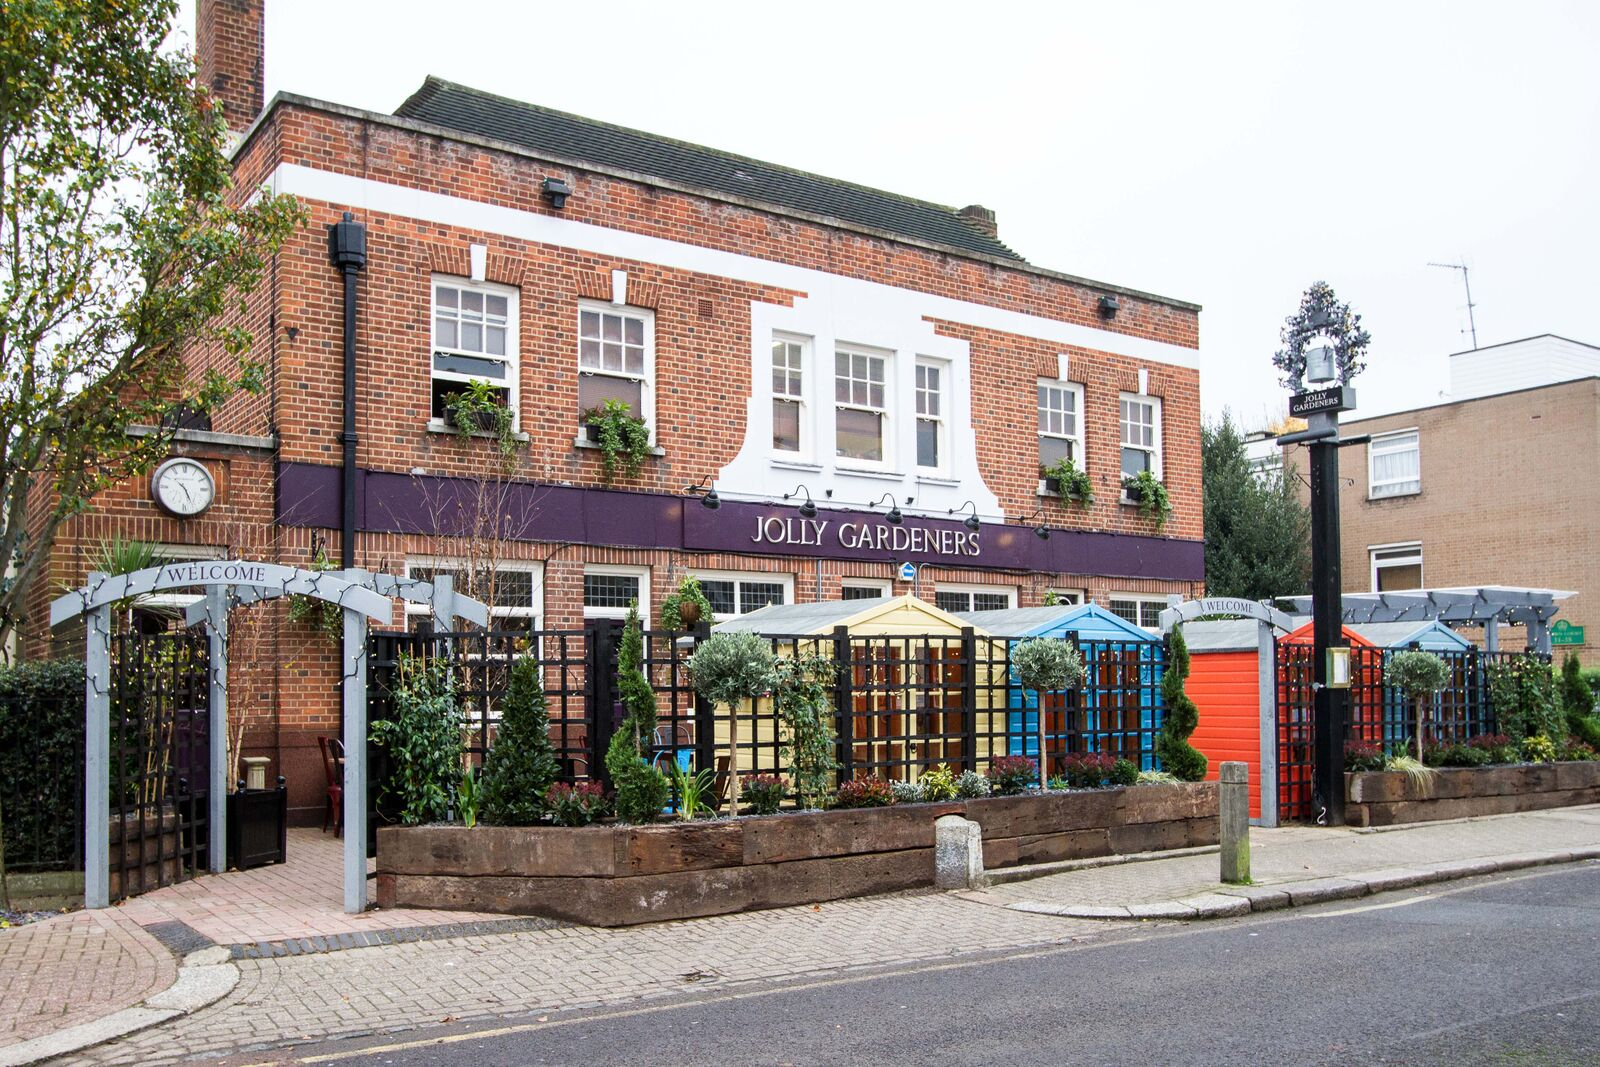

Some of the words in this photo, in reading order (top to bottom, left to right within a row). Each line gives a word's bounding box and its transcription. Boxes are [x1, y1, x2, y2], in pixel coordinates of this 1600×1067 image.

[1293, 397, 1338, 412] GARDENERS
[1304, 392, 1327, 403] JOLLY
[752, 516, 827, 546] JOLLY
[838, 523, 980, 556] GARDENERS
[167, 565, 265, 582] WELCOME
[1207, 600, 1253, 613] WELCOME
